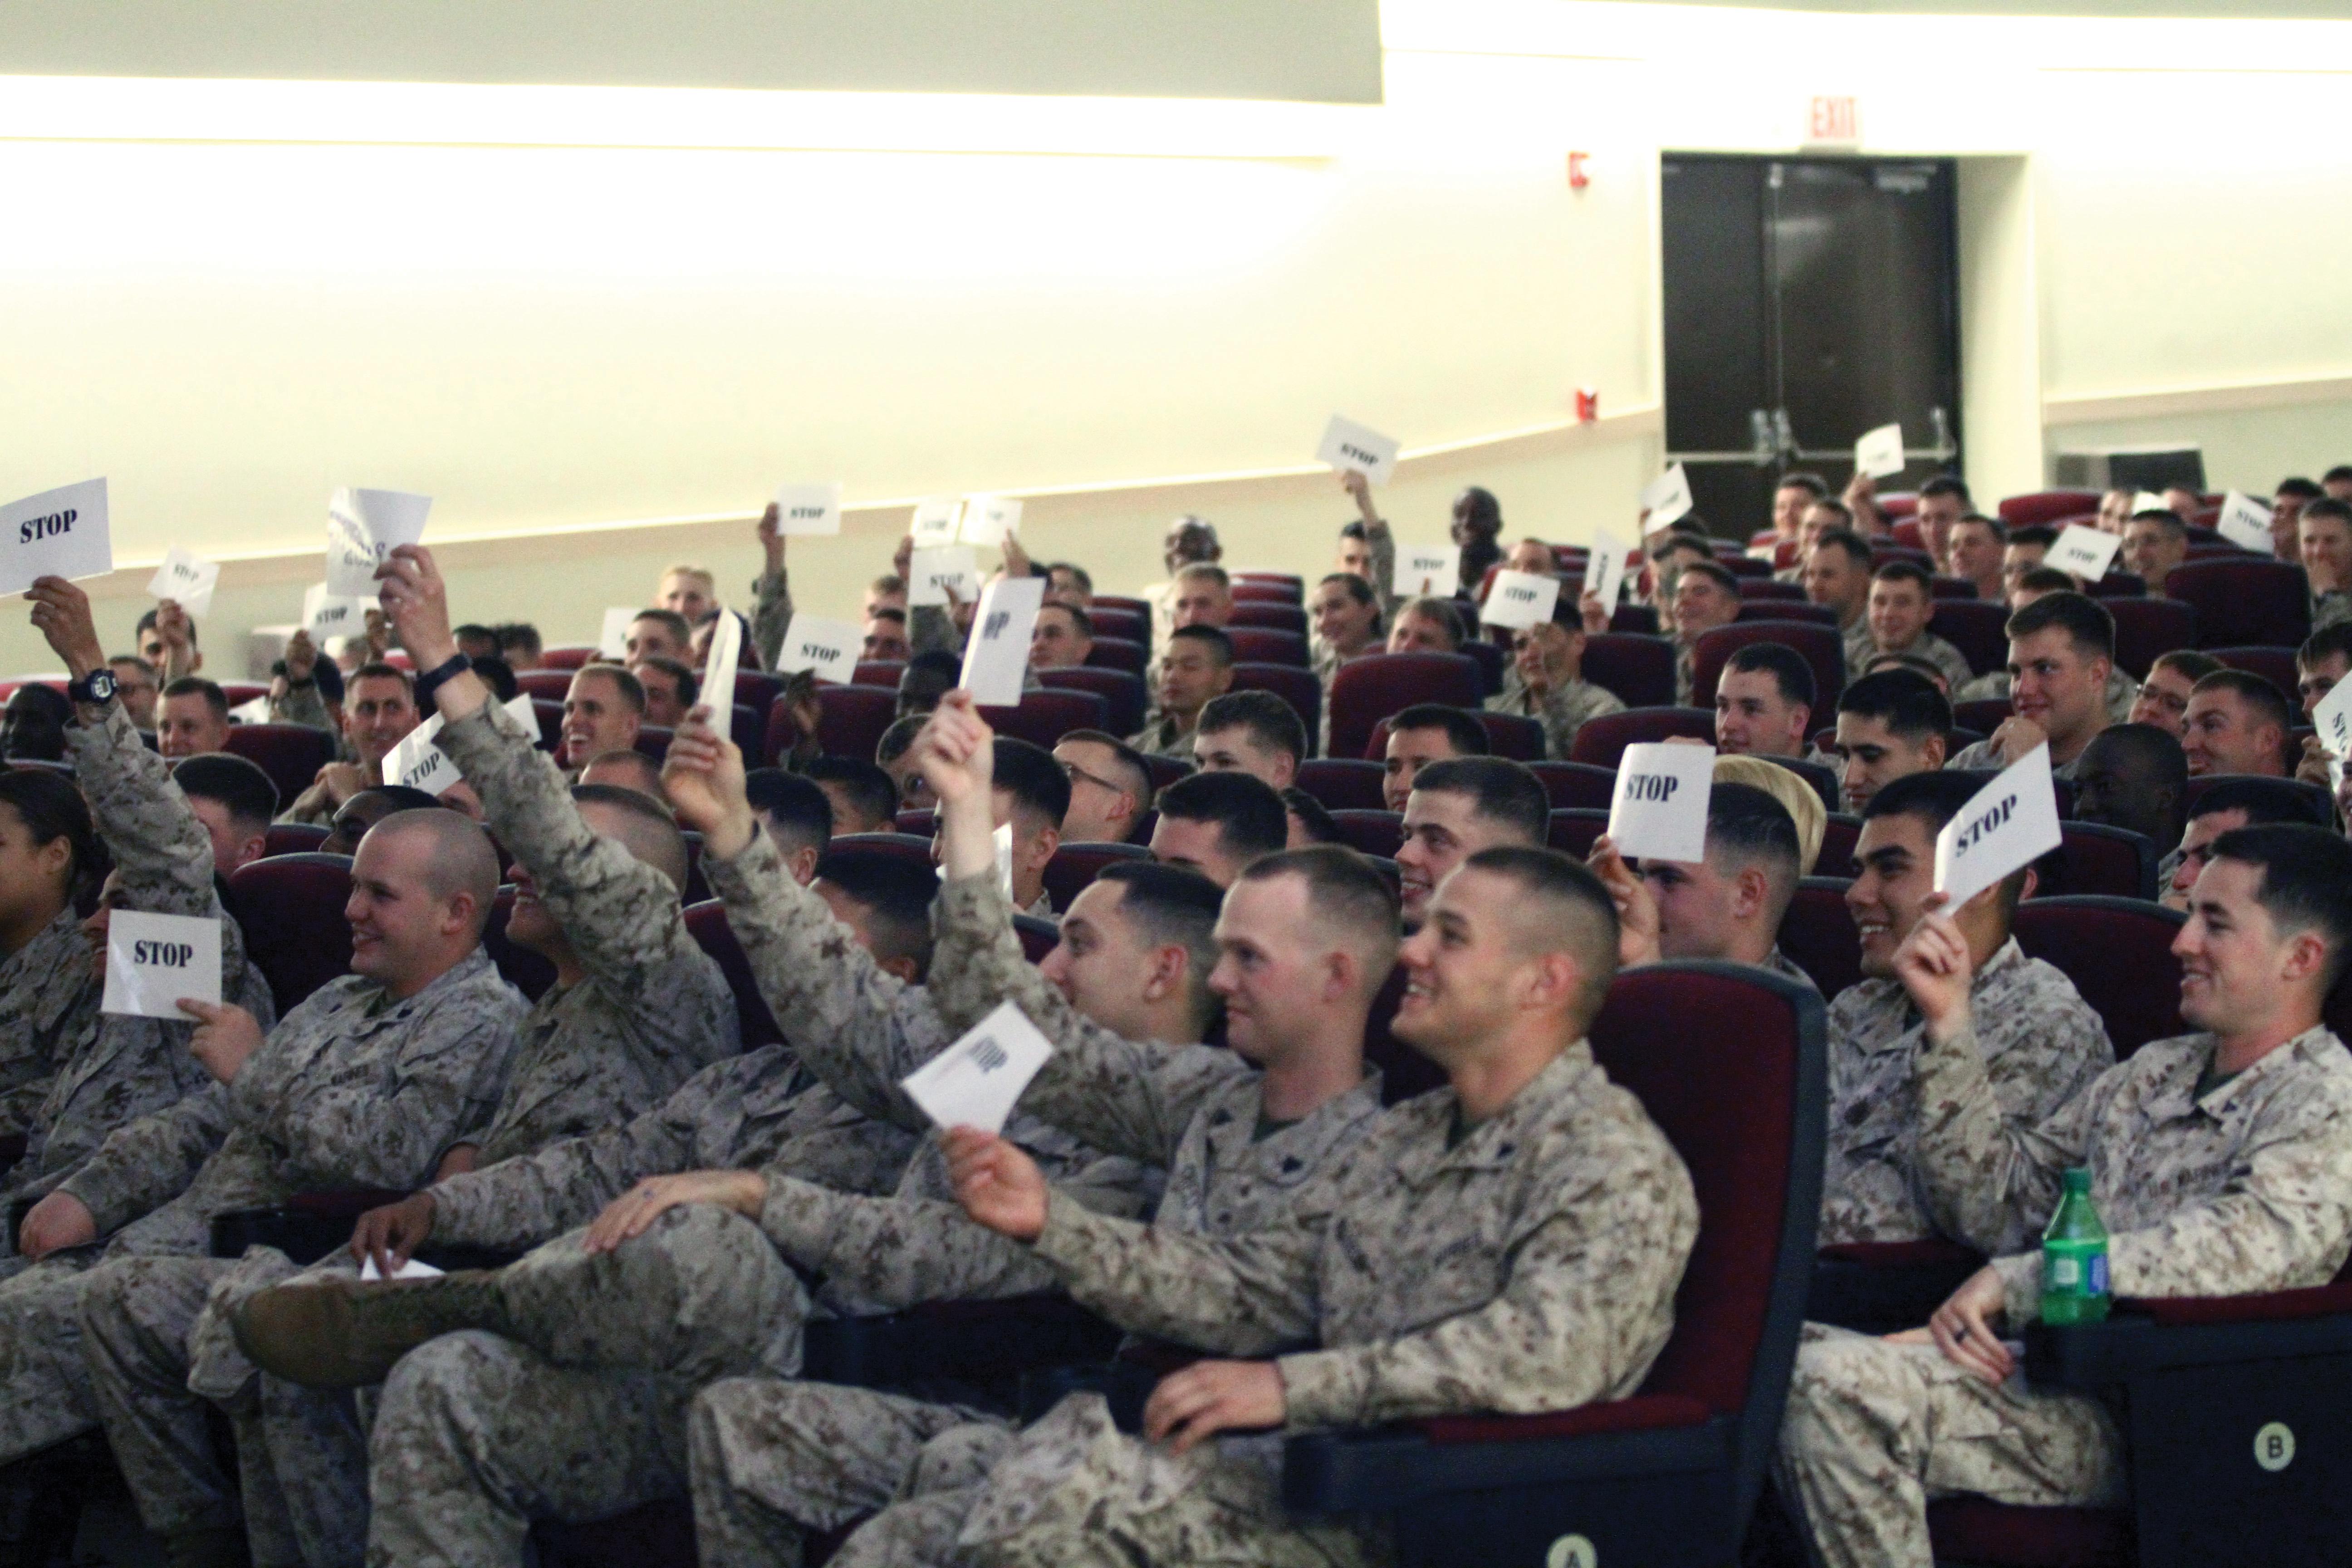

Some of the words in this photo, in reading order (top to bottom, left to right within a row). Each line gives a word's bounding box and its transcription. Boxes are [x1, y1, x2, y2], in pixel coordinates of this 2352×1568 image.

[1812, 96, 1856, 138] EXIT
[1341, 443, 1379, 465] STOP
[790, 507, 825, 519] STOP
[2237, 508, 2265, 529] STOP
[20, 509, 78, 544] STOP
[1413, 558, 1445, 570] STOP
[2068, 548, 2098, 563] STOP
[1505, 587, 1537, 603] STOP
[316, 606, 348, 624] STOP
[801, 644, 840, 662] STOP
[403, 751, 440, 788] STOP
[1624, 774, 1678, 802] STOP
[1956, 794, 2017, 858] STOP
[134, 939, 193, 967] STOP
[2268, 1435, 2283, 1459] B
[1564, 1549, 1583, 1568] A
